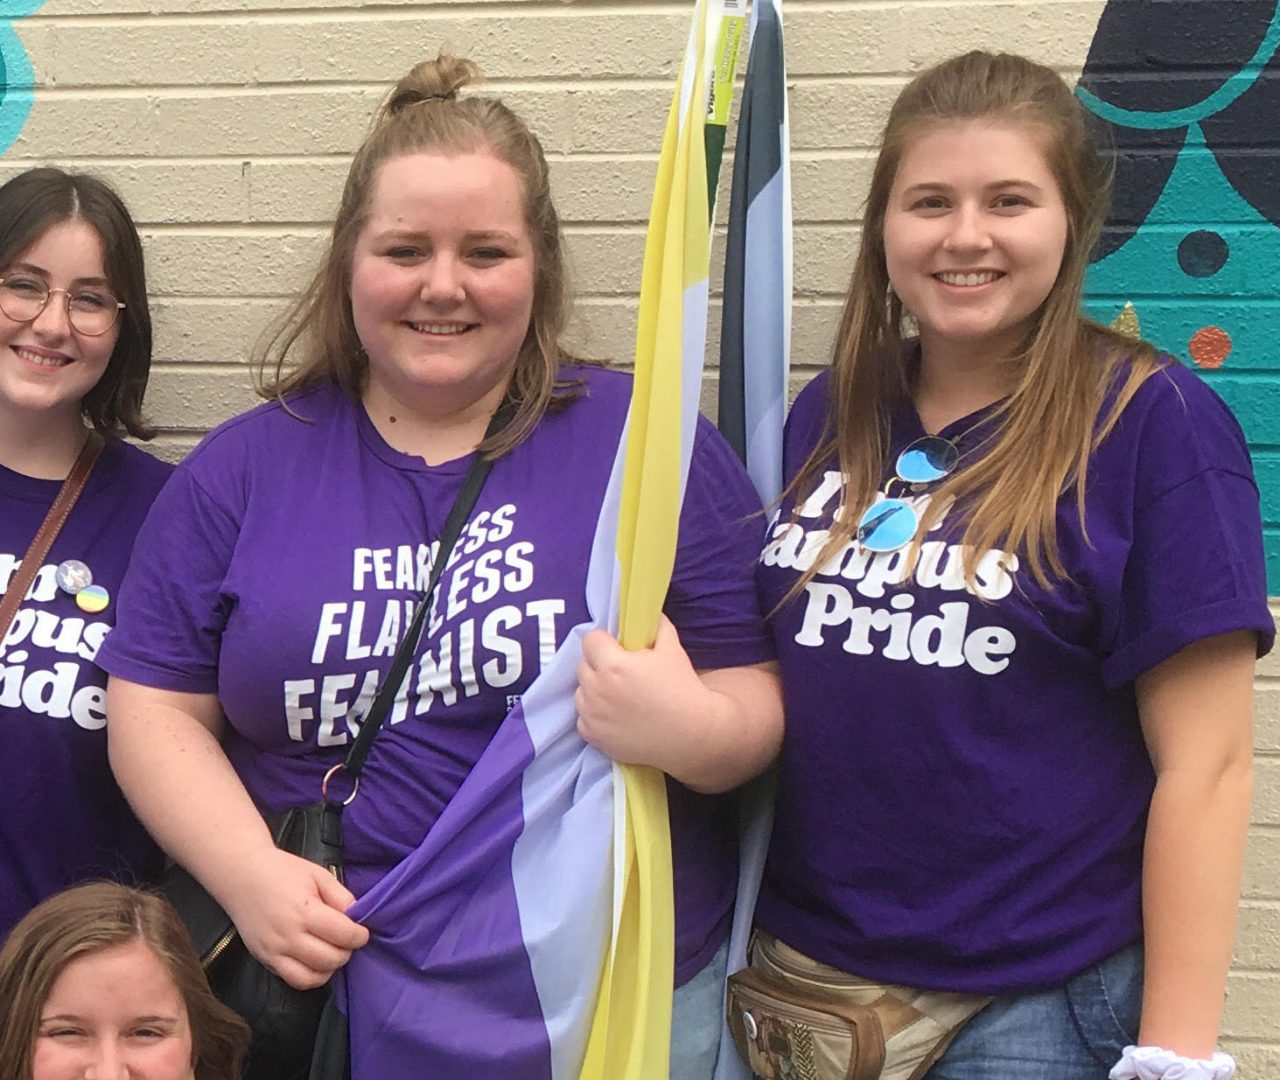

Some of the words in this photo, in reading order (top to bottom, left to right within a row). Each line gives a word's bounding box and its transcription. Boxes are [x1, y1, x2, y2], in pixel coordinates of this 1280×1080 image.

[792, 471, 850, 518] I
[760, 509, 1019, 600] ampus
[311, 541, 534, 664] FLALESS
[795, 583, 1016, 675] Pride
